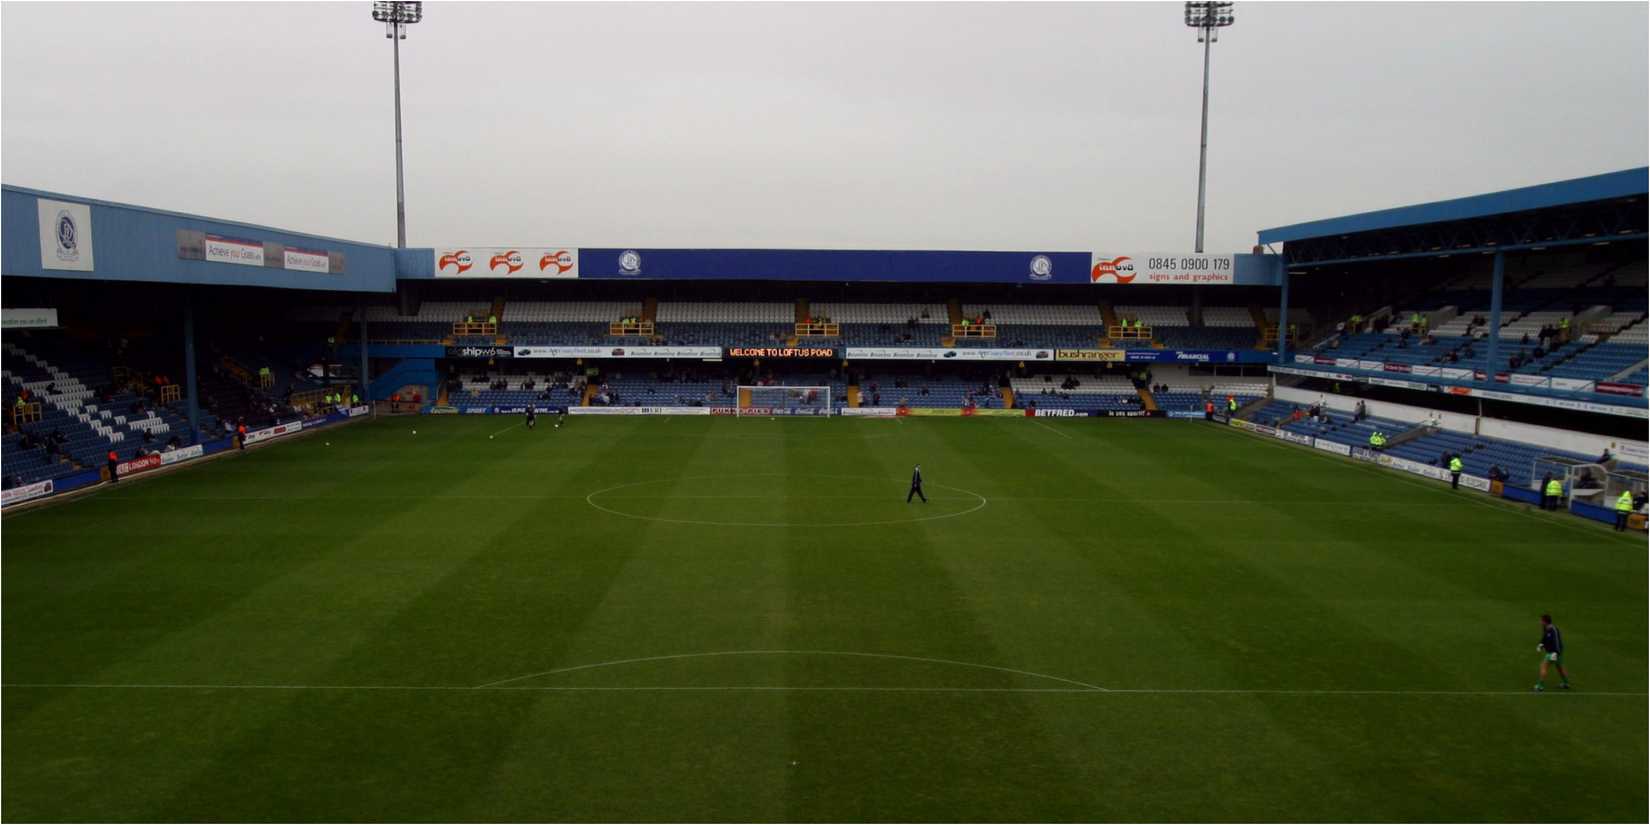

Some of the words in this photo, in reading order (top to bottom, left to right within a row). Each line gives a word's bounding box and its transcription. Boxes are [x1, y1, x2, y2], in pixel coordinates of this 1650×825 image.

[1148, 257, 1177, 270] 0845
[1181, 258, 1209, 270] 0900
[1213, 258, 1230, 270] 179
[1149, 272, 1170, 281] signs
[1173, 272, 1190, 281] and
[1192, 272, 1229, 282] graphics
[729, 348, 766, 357] WELCOME
[767, 348, 778, 357] TO
[778, 348, 810, 357] LOFTUS
[1057, 350, 1118, 360] bushranger
